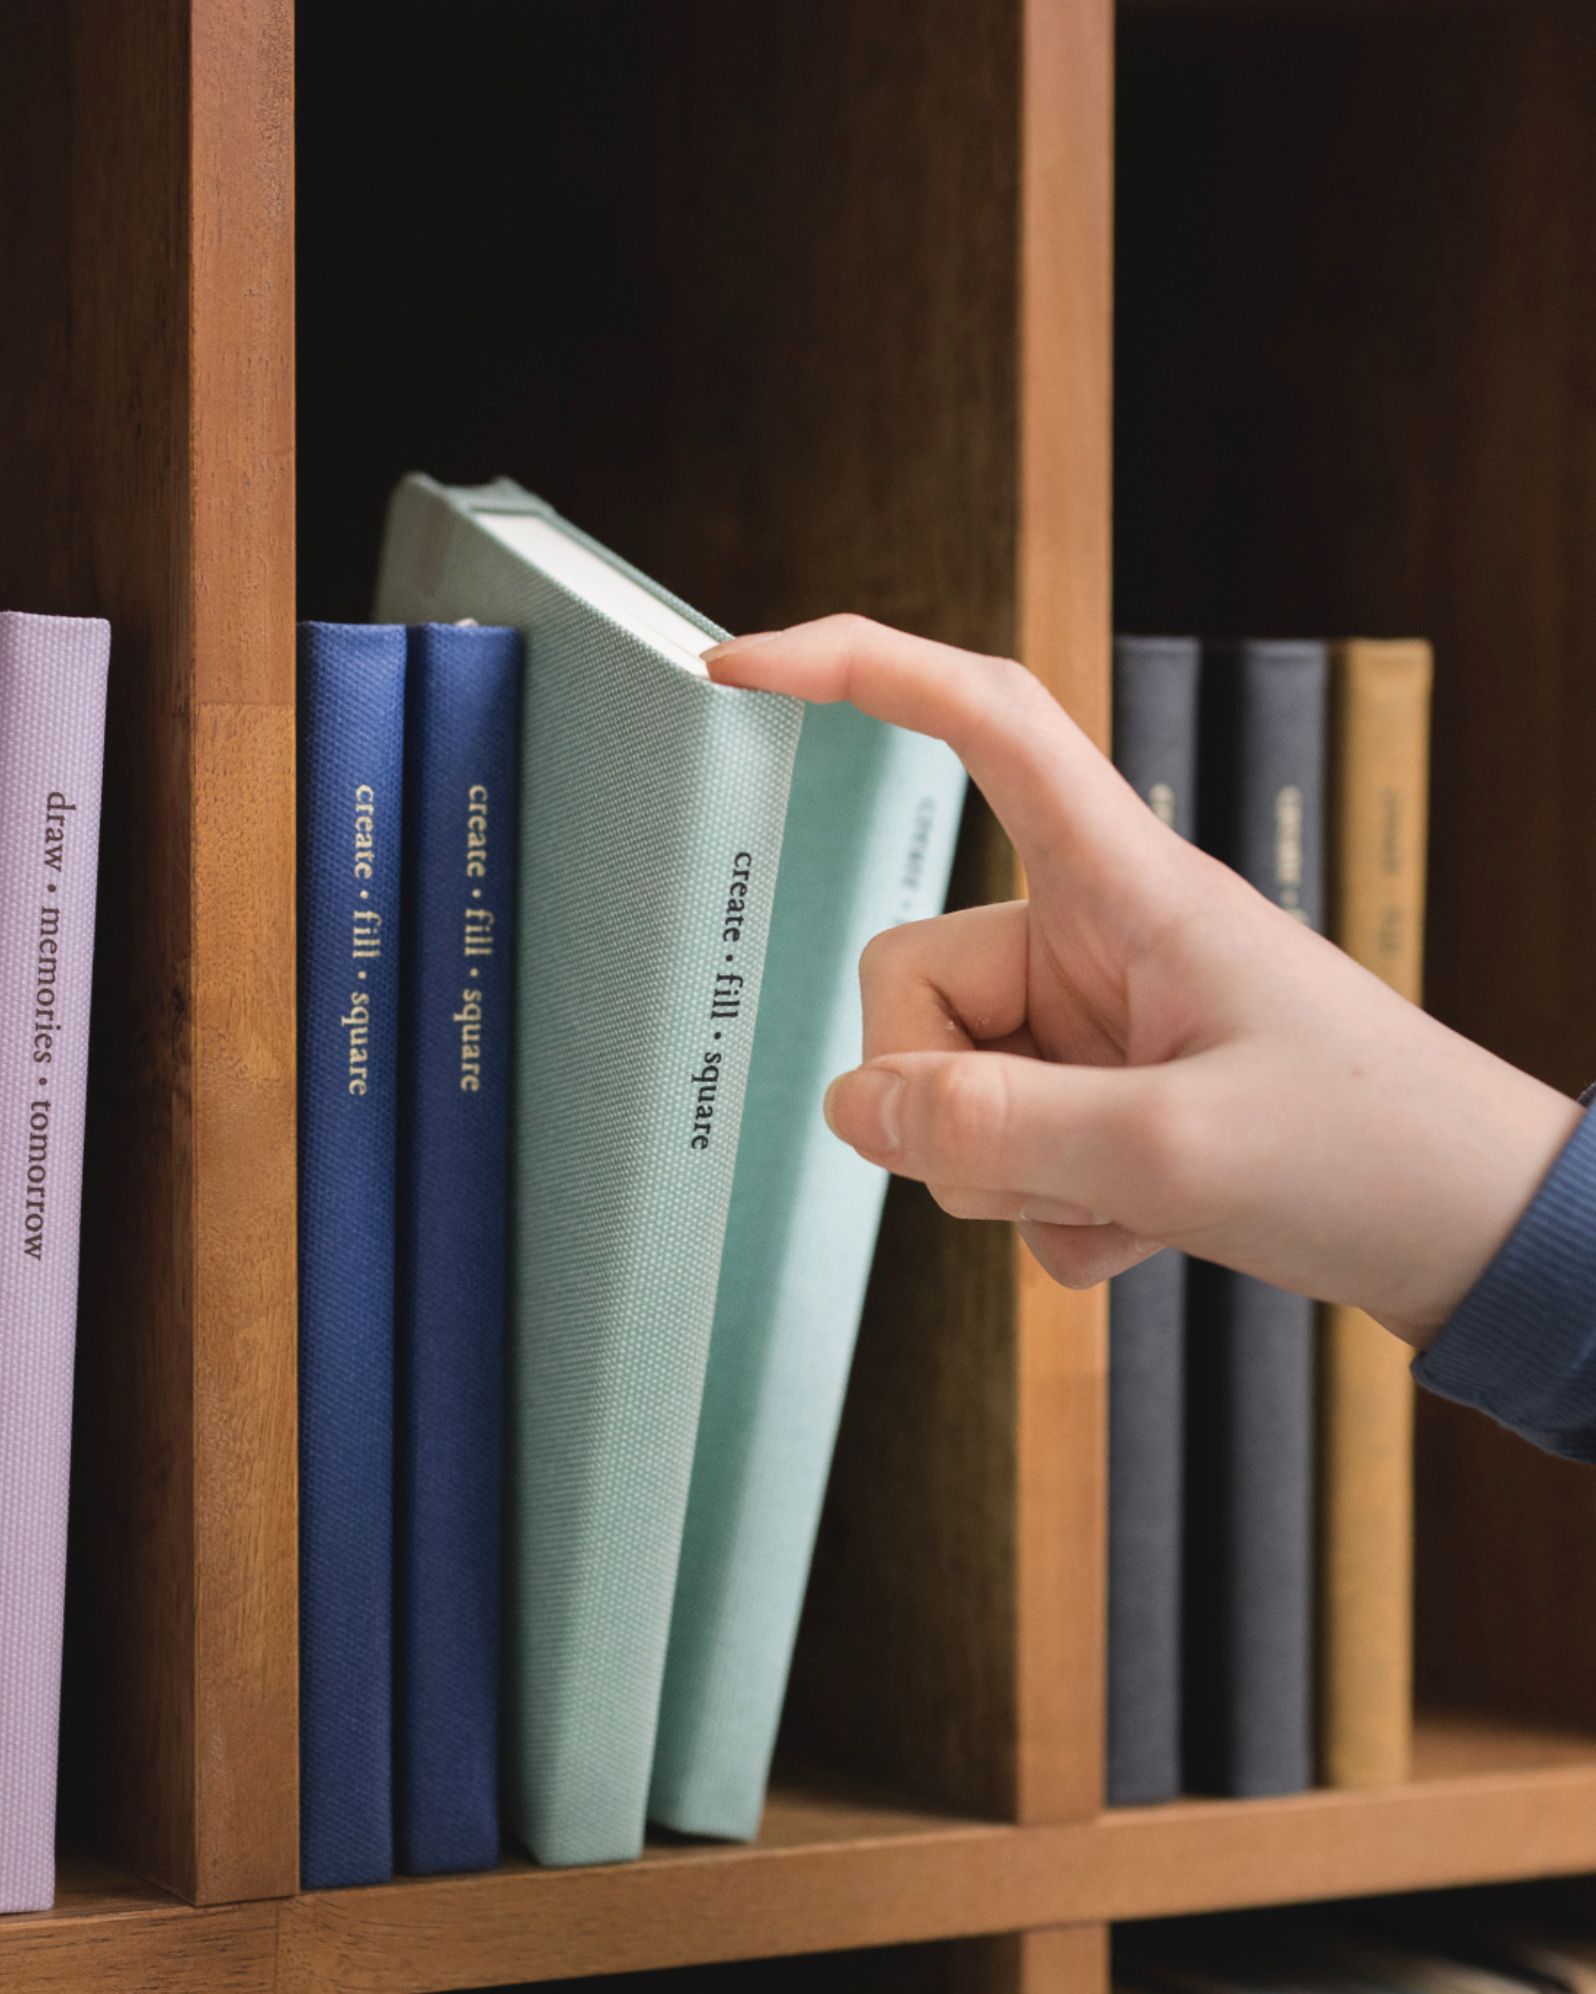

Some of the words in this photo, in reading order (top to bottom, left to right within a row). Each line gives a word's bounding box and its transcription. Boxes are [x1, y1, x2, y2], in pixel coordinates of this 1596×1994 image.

[45, 790, 76, 872] draw
[354, 784, 374, 879] create
[467, 785, 488, 878] create
[352, 910, 382, 958] fill
[465, 908, 494, 956] fill
[722, 852, 753, 942] create
[33, 905, 62, 1064] memories
[710, 972, 744, 1020] fill
[341, 992, 370, 1096] square
[453, 989, 482, 1092] square
[691, 1051, 721, 1150] square
[24, 1099, 53, 1261] tomorrow
